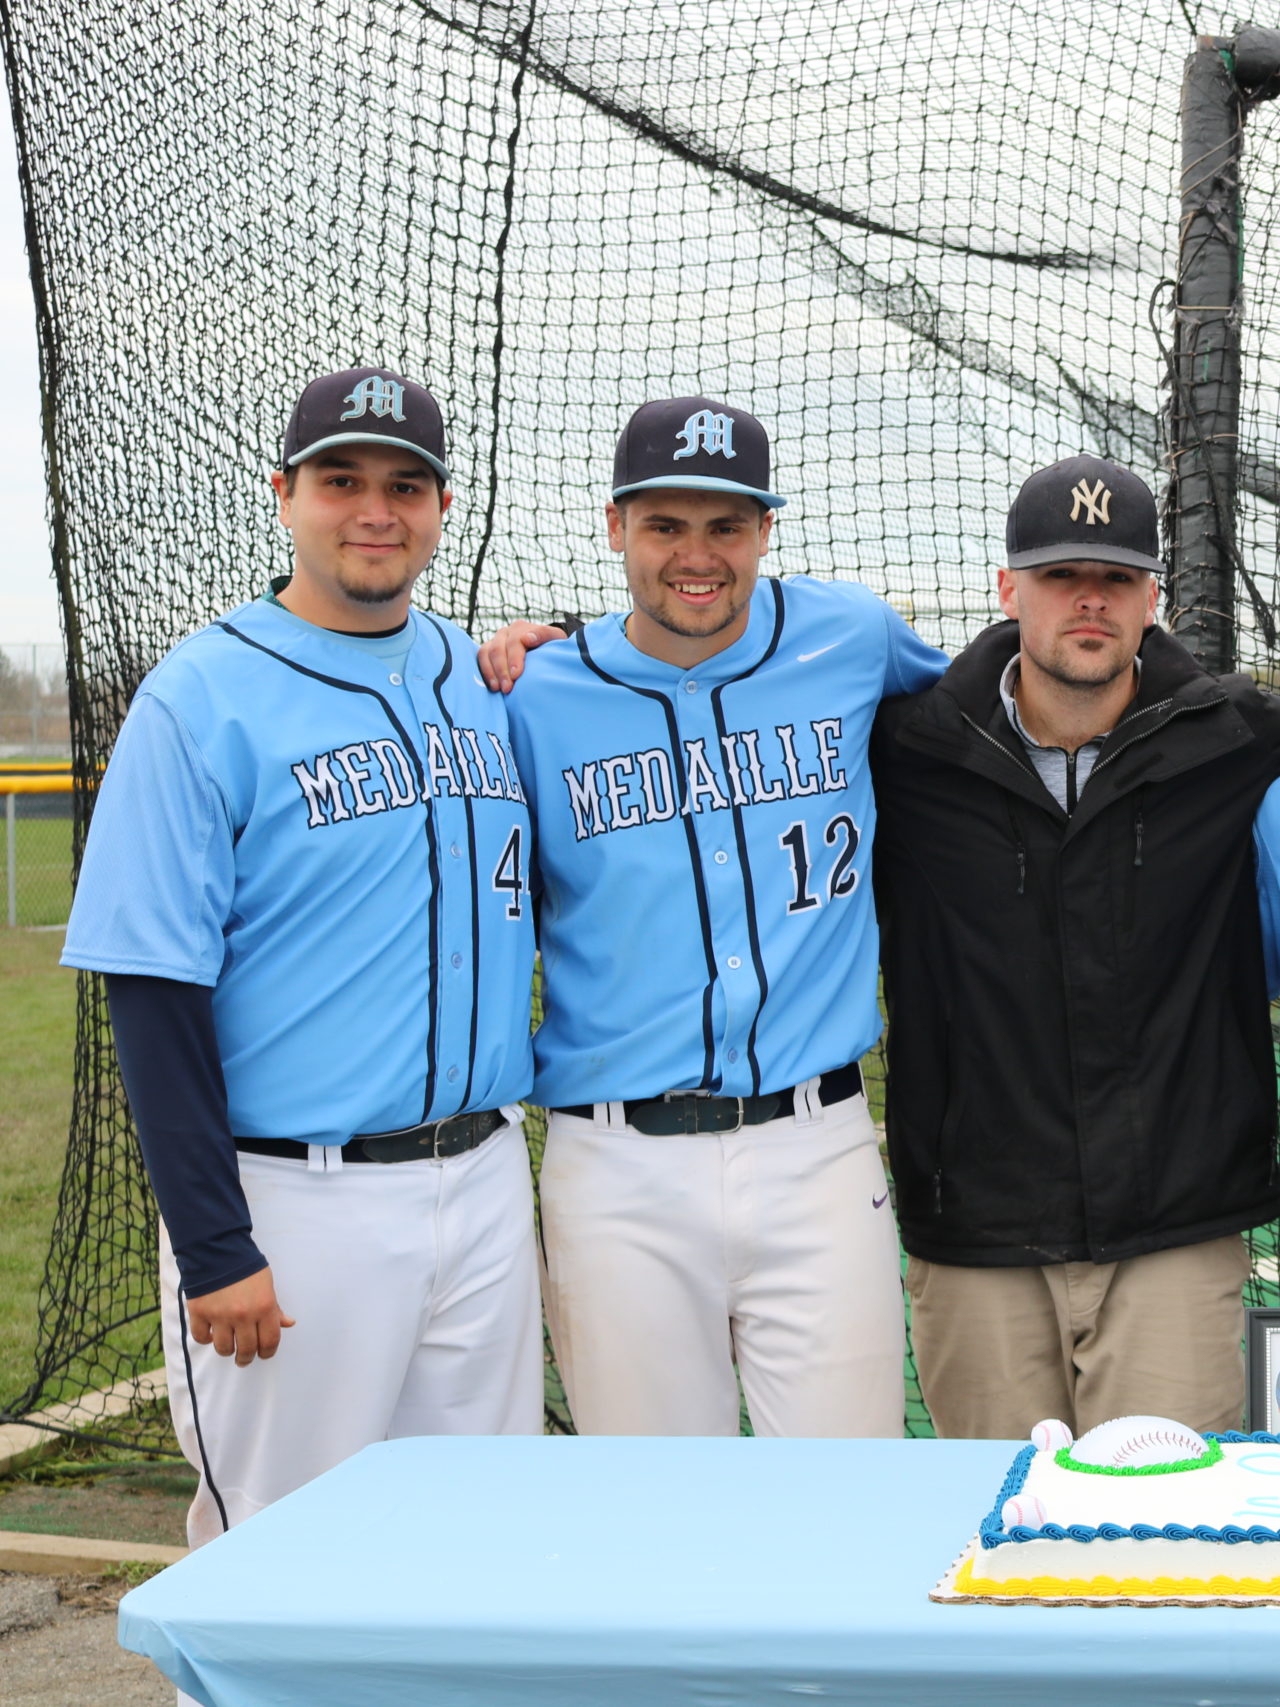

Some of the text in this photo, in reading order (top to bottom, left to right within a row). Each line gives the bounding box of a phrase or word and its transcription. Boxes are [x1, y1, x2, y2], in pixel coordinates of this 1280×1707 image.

[293, 723, 528, 829] MEDAILL
[563, 718, 847, 842] MEDAILLE
[492, 824, 532, 921] 4
[779, 811, 861, 915] 12
